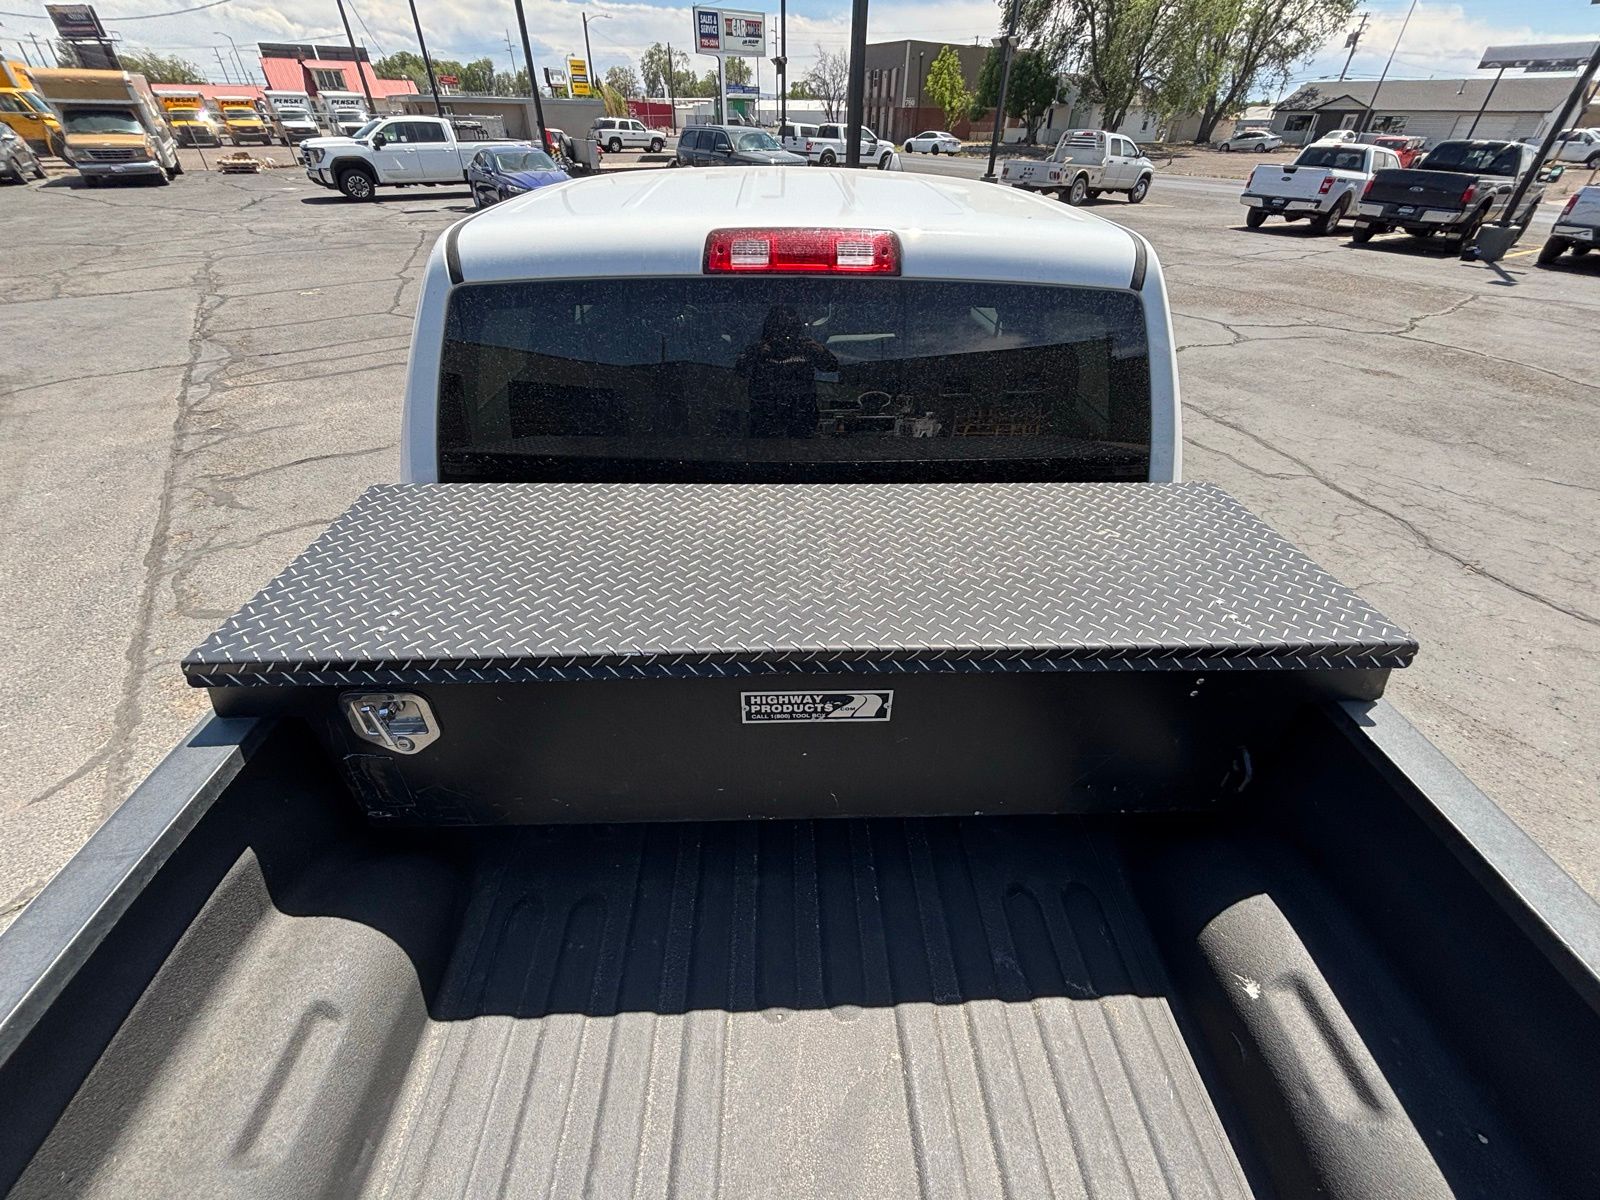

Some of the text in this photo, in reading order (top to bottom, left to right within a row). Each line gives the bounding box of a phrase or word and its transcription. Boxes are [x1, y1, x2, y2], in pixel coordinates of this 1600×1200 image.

[700, 14, 713, 24] SALES
[700, 24, 718, 35] SERVICE
[732, 18, 746, 37] CAR
[750, 694, 824, 704] HIGHWAY
[750, 703, 834, 713] PRODUCTS
